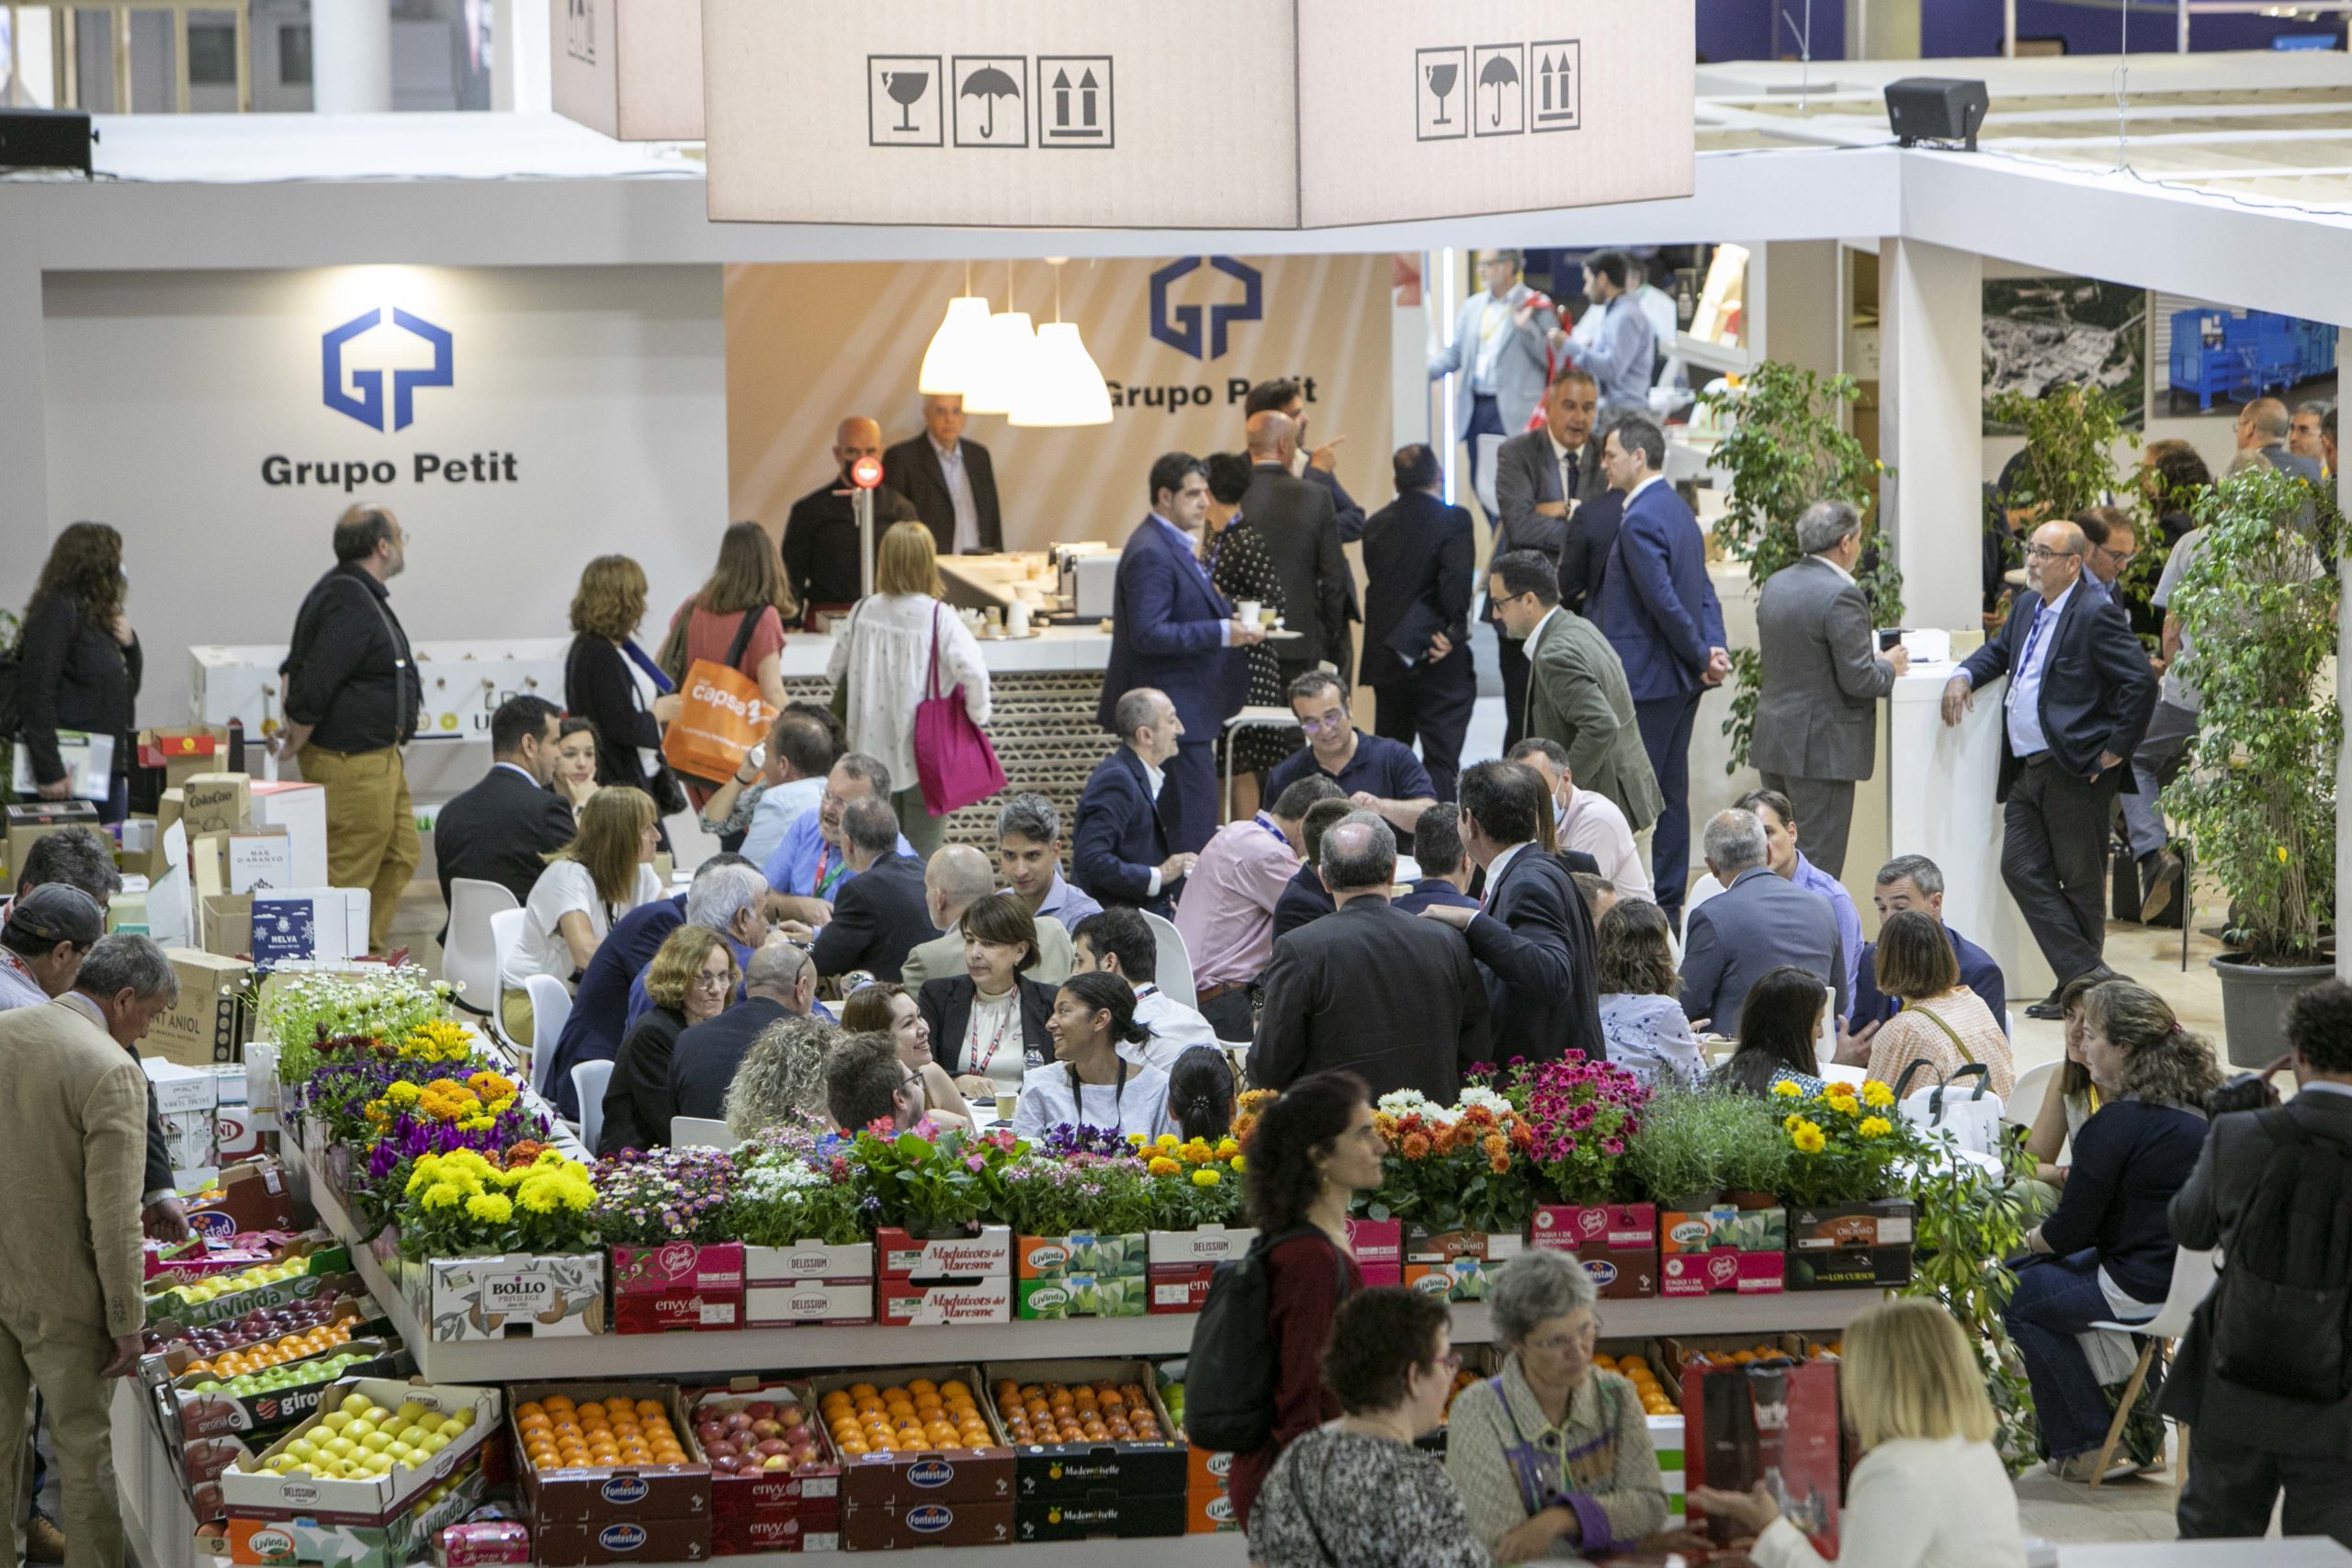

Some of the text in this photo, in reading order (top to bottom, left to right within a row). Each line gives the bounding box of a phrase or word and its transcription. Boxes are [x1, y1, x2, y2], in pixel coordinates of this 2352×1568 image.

[1105, 380, 1213, 412] Grupo
[262, 451, 517, 492] Grupo Petit
[692, 684, 746, 716] capsa
[189, 790, 232, 808] ColaCao
[271, 935, 298, 943] MELVA
[149, 1011, 200, 1034] NT ANIOL
[1838, 1225, 1873, 1235] ORCHARD
[1193, 1241, 1229, 1252] DELISSIUM
[1447, 1242, 1484, 1250] ORCHARD
[666, 1247, 690, 1264] Pink
[929, 1247, 991, 1260] Maduixots
[992, 1249, 1005, 1258] del
[670, 1257, 694, 1271] Lady
[791, 1258, 827, 1269] DELISSIUM
[940, 1259, 994, 1270] Maresme
[1588, 1268, 1614, 1280] testad
[492, 1281, 546, 1295] BOLLO
[1189, 1280, 1211, 1291] env
[498, 1294, 540, 1303] PRIVILEGE
[792, 1299, 827, 1310] DELISSIUM
[929, 1293, 1006, 1307] Maduixots del
[655, 1299, 689, 1316] envy
[940, 1306, 994, 1318] Maresme
[281, 1390, 323, 1415] giro
[1065, 1465, 1120, 1475] Mademoiselle
[1212, 1456, 1232, 1472] Livi
[910, 1469, 950, 1481] Fontestad
[283, 1487, 317, 1498] DELISSIUM
[605, 1482, 645, 1496] Fontestad
[752, 1483, 786, 1500] envy
[1064, 1509, 1119, 1520] Mademoiselle
[1211, 1500, 1232, 1517] Livi
[910, 1514, 949, 1525] Fontestad
[603, 1529, 642, 1543] Fontestad
[750, 1522, 782, 1540] envy
